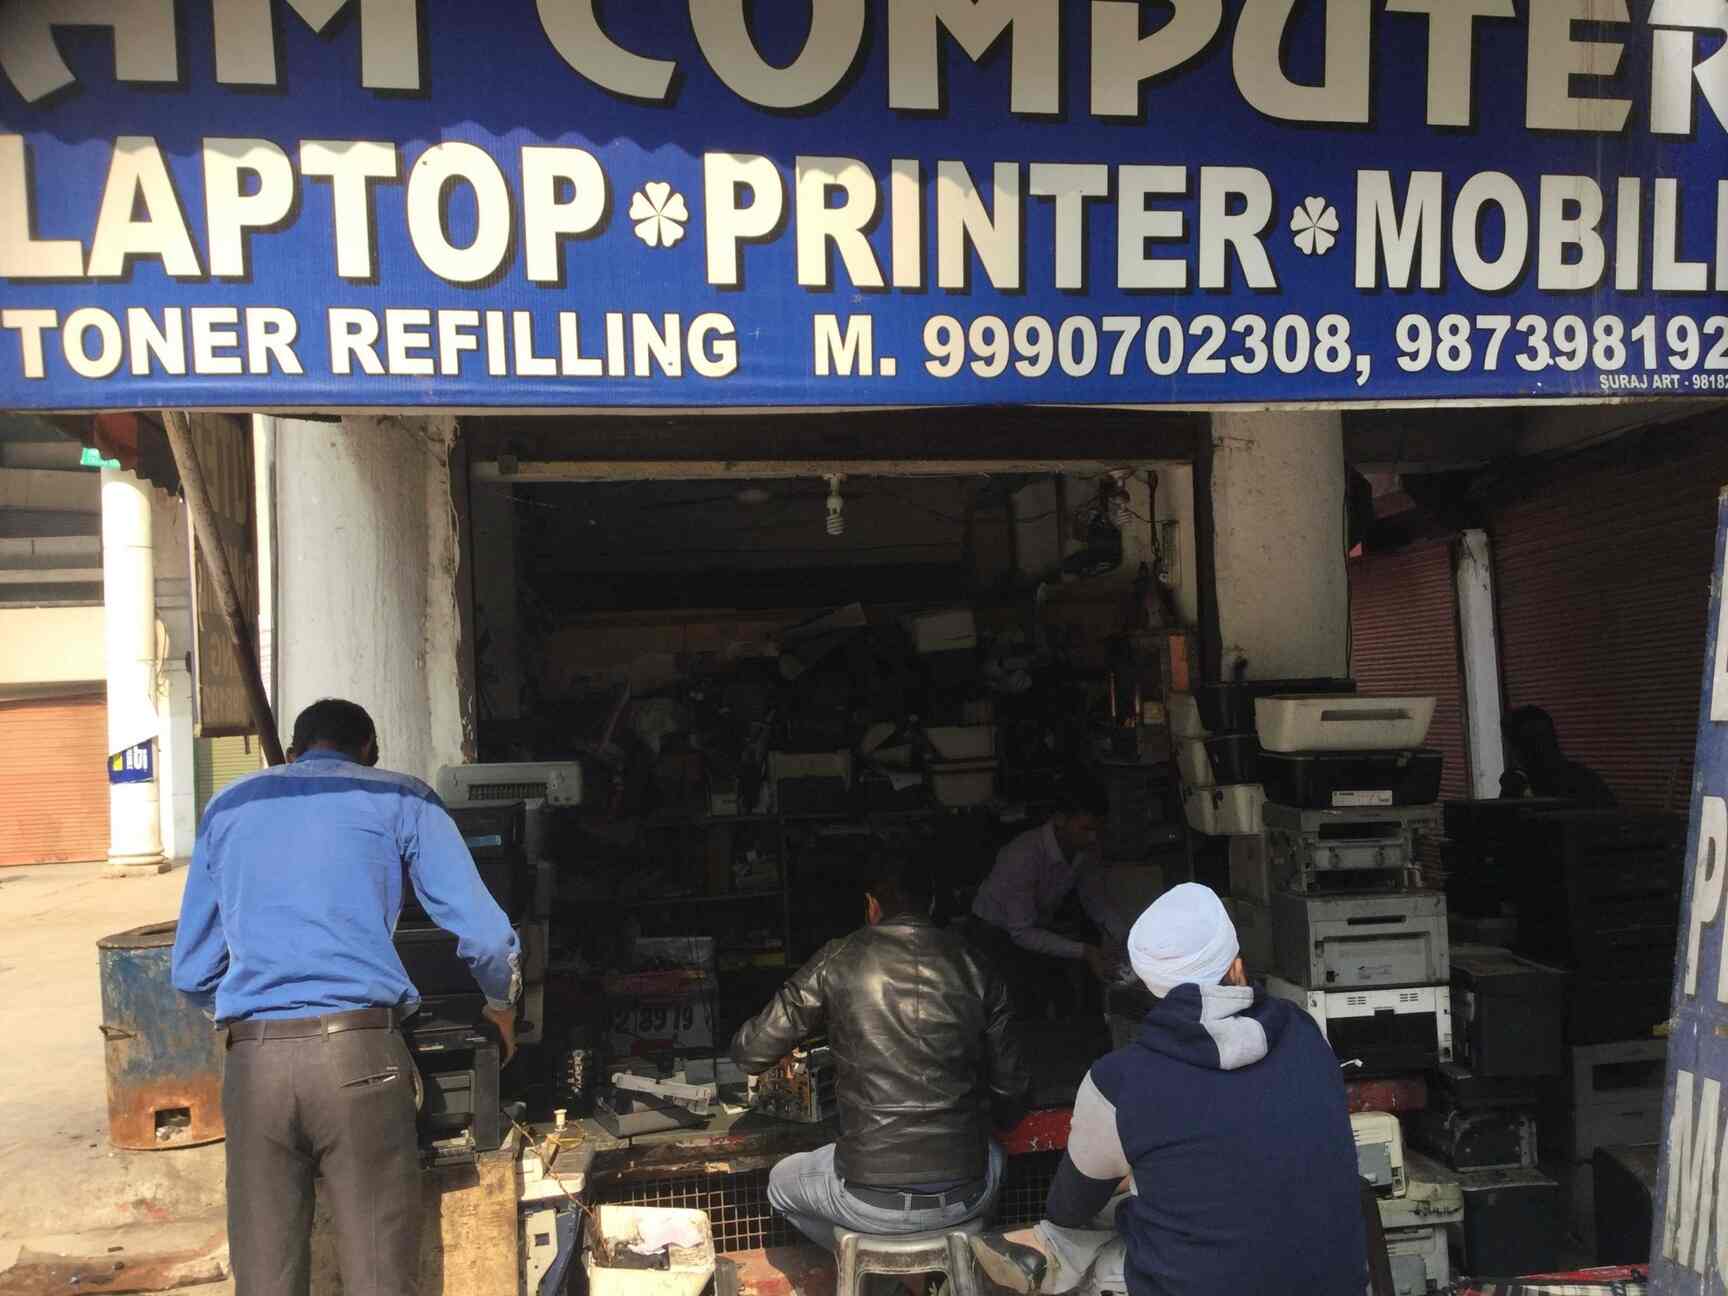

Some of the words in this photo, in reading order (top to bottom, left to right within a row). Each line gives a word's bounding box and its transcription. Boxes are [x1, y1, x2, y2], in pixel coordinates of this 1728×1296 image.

[0, 134, 606, 283] LAPTOP
[704, 152, 1277, 289] PRINTER
[1355, 169, 1728, 291] MOBIL
[3, 306, 303, 378] TONER
[328, 307, 738, 378] REFILLING
[813, 314, 896, 377] M.
[923, 313, 1372, 386] 9990702308,
[1395, 313, 1728, 372] 987398192
[1599, 374, 1648, 389] SURAJ
[1652, 374, 1681, 389] ART
